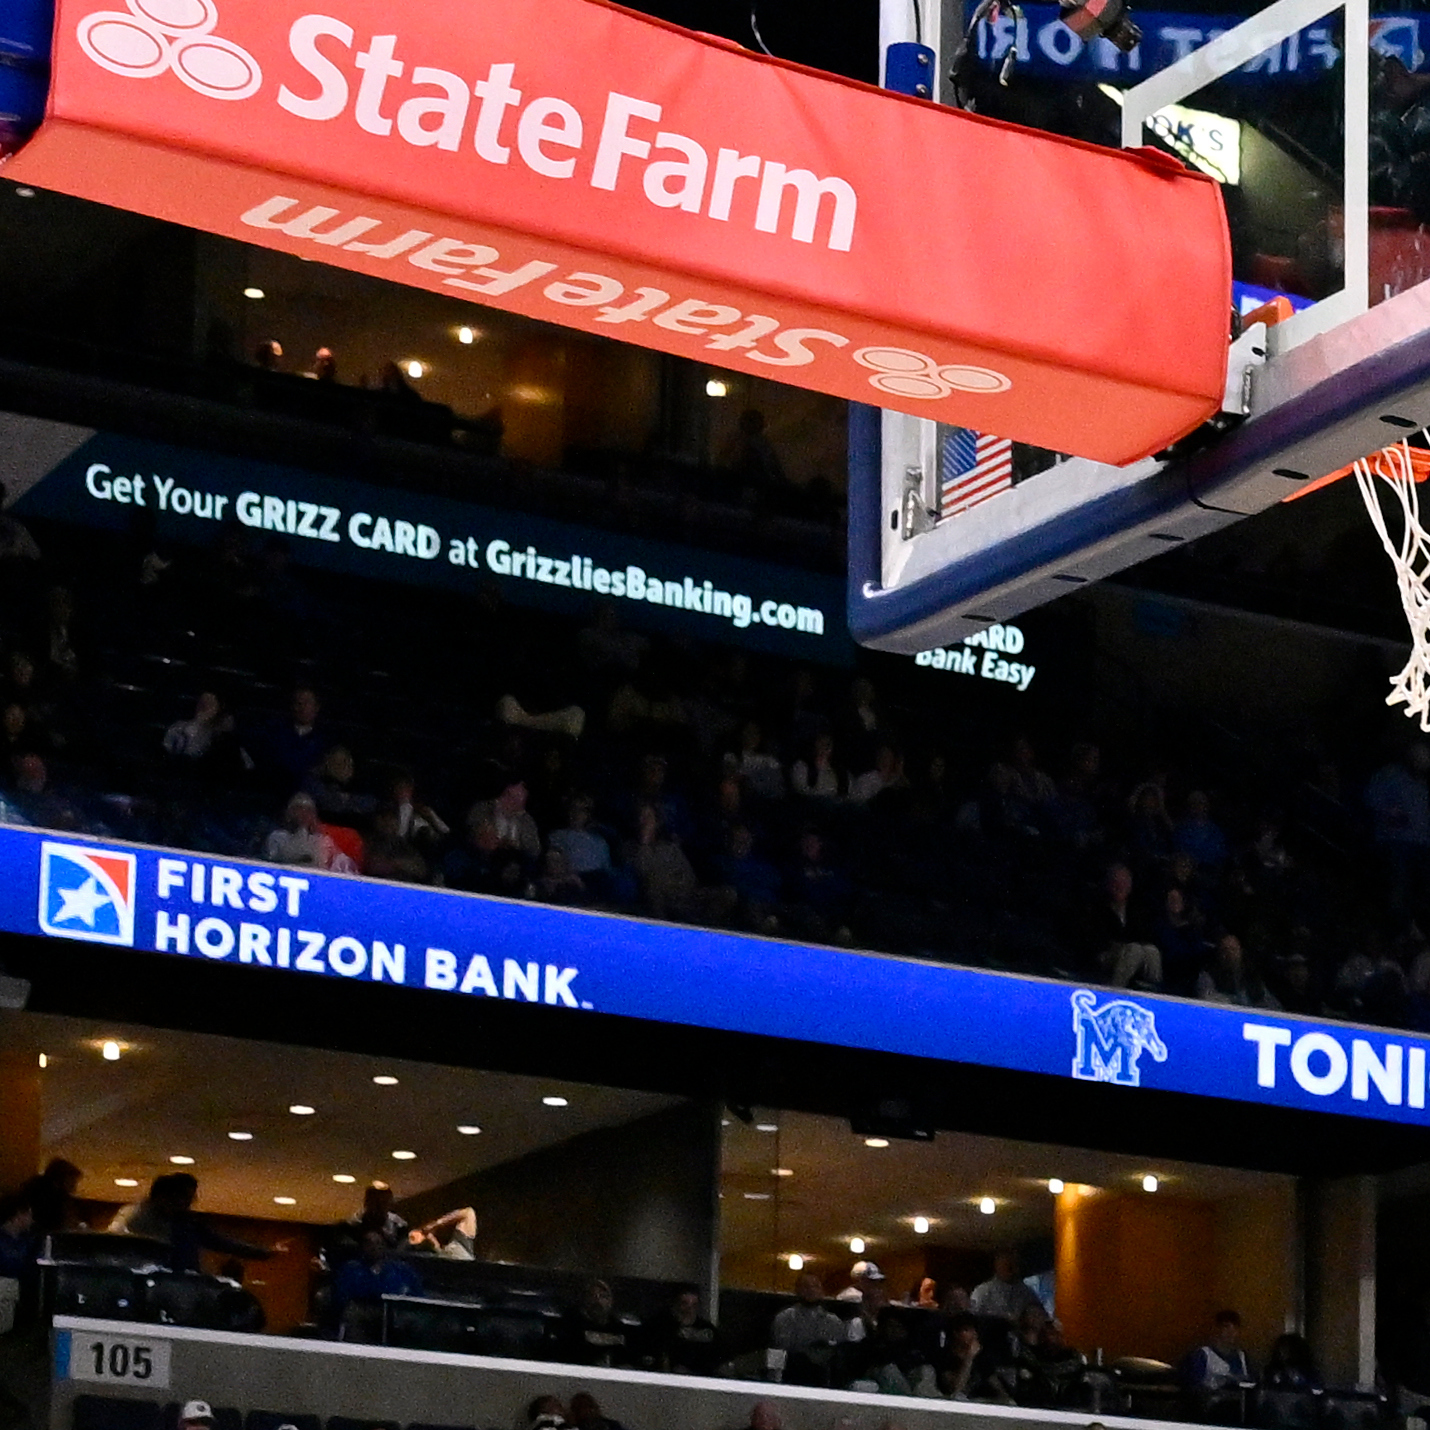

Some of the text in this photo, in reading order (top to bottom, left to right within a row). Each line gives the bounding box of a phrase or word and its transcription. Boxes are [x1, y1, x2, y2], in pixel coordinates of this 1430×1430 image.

[85, 463, 825, 635] Get Your GRIZZ CARD at GrizzliesBanking.com
[980, 651, 1036, 691] Easy
[158, 858, 309, 917] FIRST
[155, 911, 406, 984] HORIZON
[91, 1341, 152, 1379] 105
